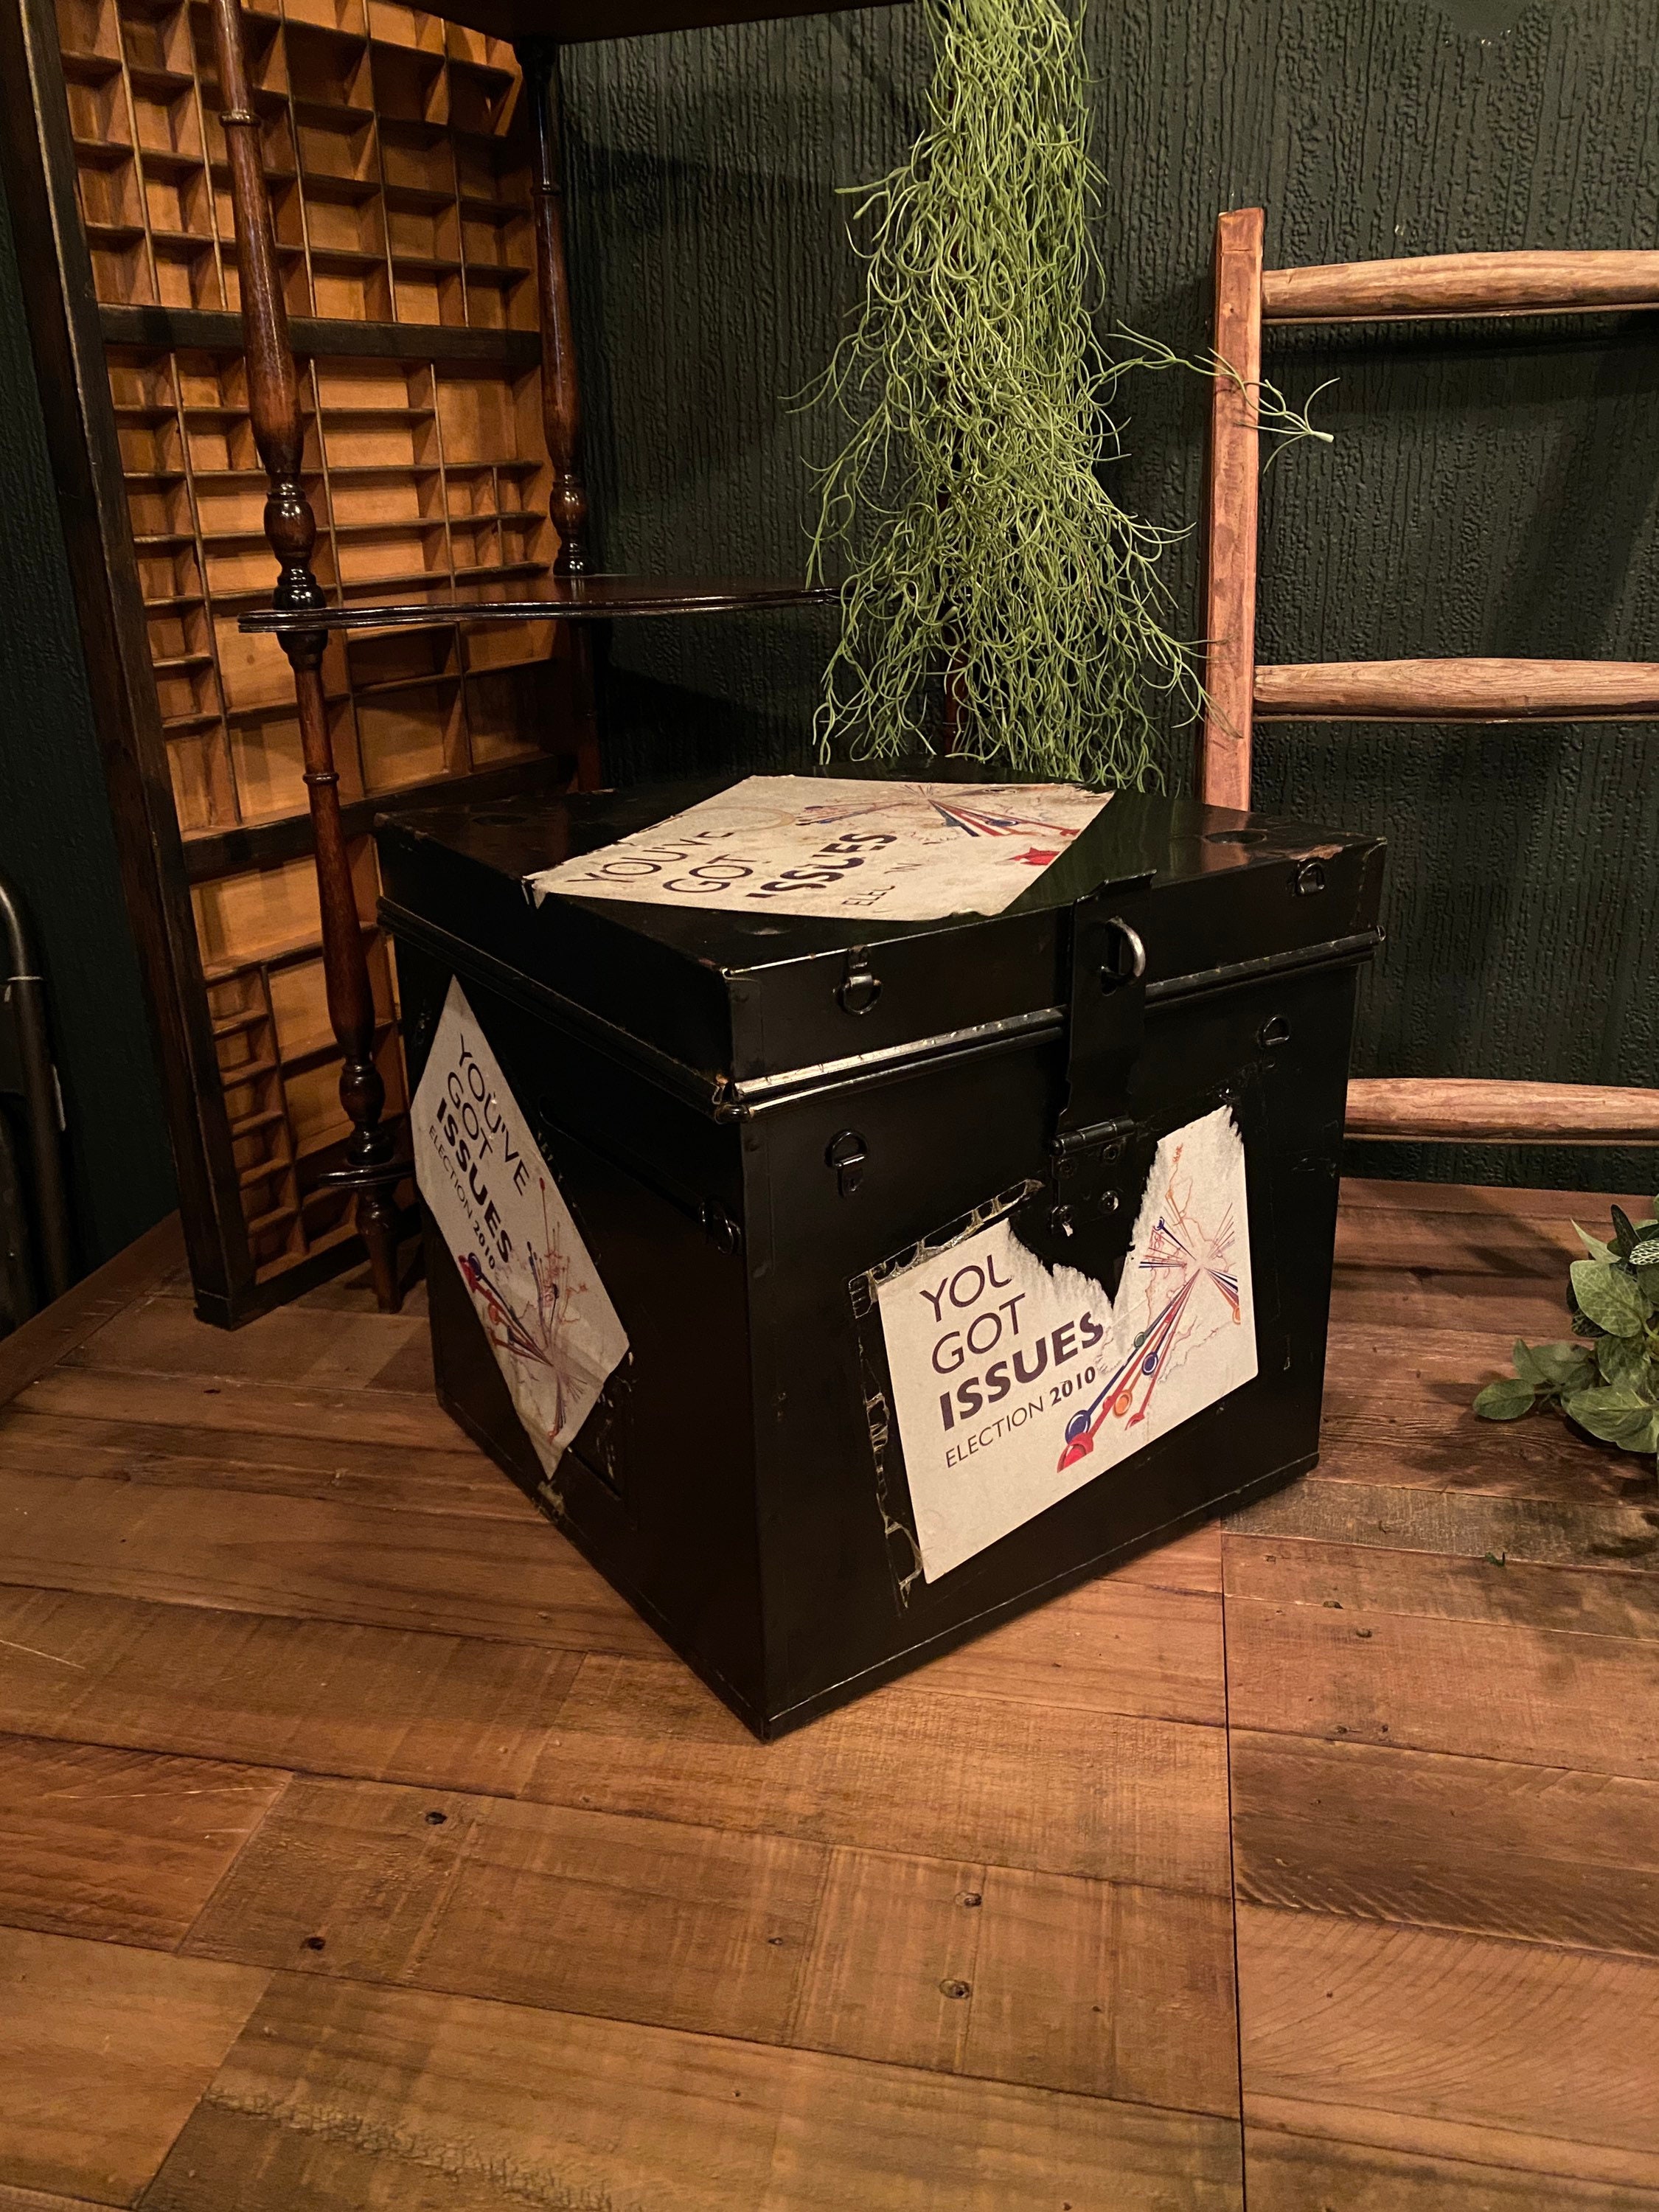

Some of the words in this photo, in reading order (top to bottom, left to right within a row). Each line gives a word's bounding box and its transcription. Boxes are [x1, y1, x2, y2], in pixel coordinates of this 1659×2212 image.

[662, 853, 771, 893] GOT
[447, 1071, 493, 1160] GOT
[459, 1033, 530, 1196] YOU'VE
[428, 1124, 473, 1219] ELECTION
[473, 1220, 495, 1270] 2010
[437, 1097, 512, 1263] ISSUES
[931, 1293, 1026, 1374] GOT
[939, 1311, 1104, 1431] ISSUES
[945, 1397, 1044, 1468] ELECTION
[1049, 1366, 1096, 1406] 2010
